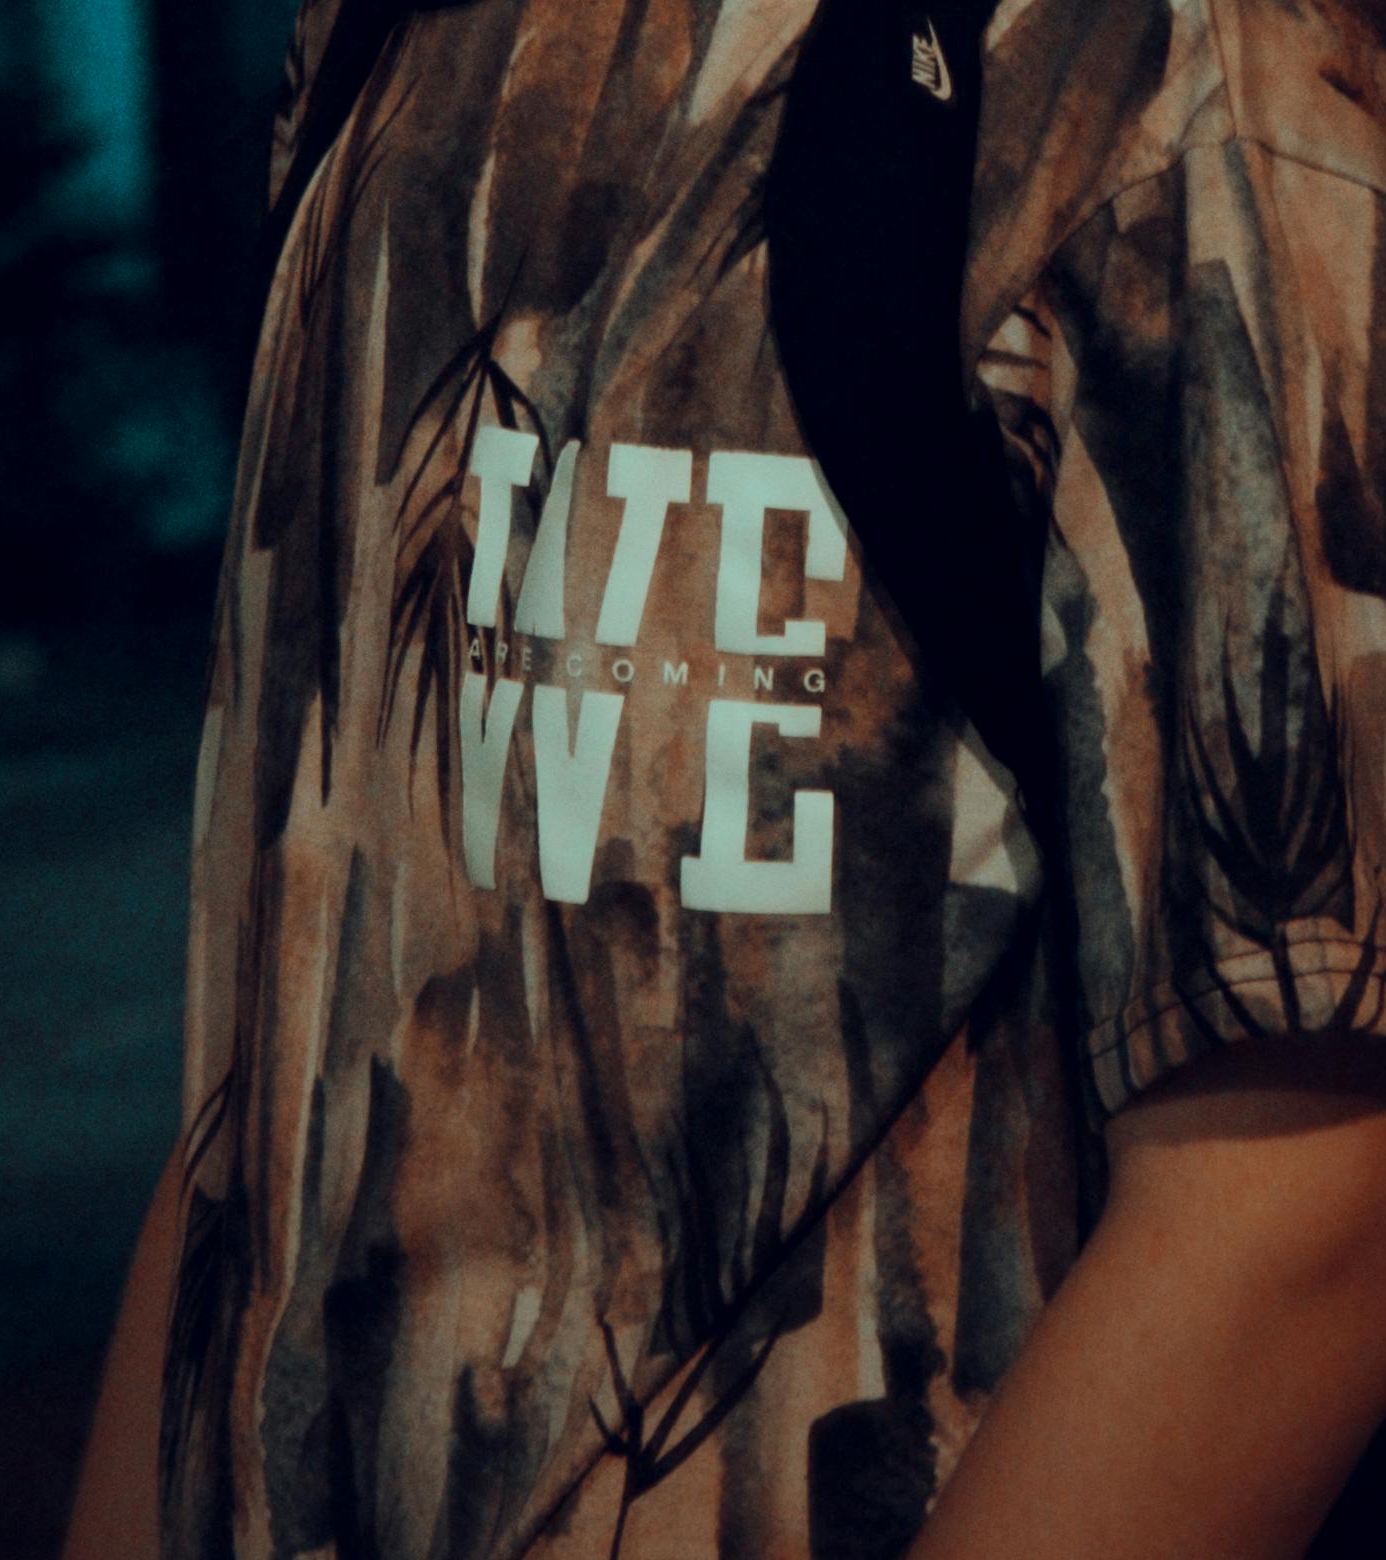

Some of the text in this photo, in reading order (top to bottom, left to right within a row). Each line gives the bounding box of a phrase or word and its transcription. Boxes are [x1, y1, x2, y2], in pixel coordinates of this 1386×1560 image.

[912, 33, 936, 90] NIKE
[468, 637, 826, 694] ARE COMING
